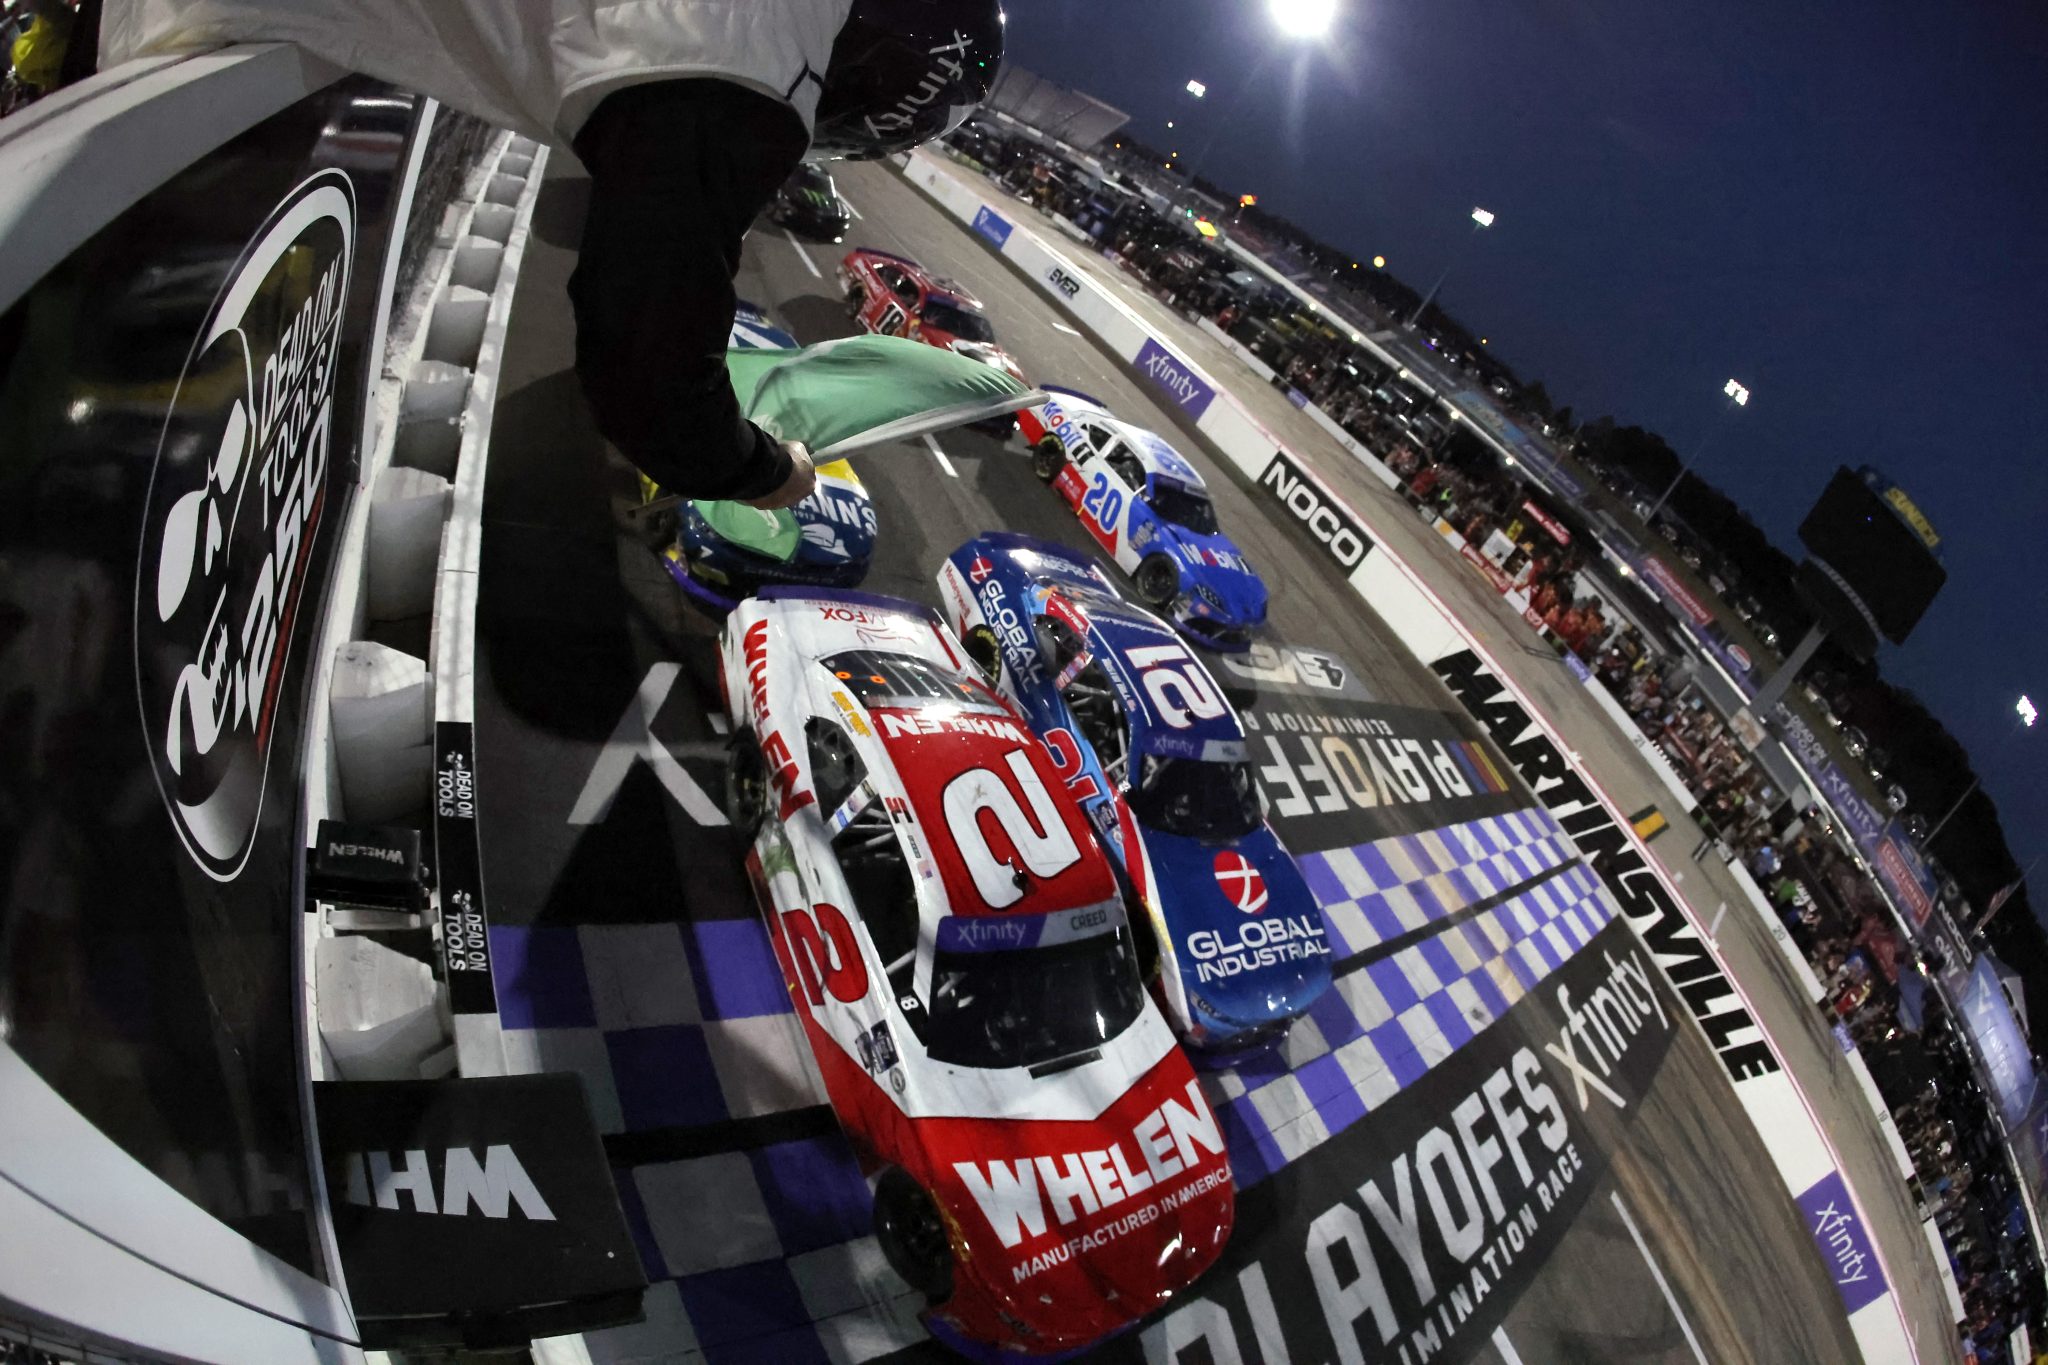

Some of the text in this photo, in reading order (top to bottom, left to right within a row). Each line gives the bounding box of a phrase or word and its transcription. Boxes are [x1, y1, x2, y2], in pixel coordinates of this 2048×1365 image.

[864, 28, 973, 139] xfinity
[259, 250, 343, 450] DEAD ON
[1145, 352, 1199, 405] xfinity
[259, 341, 327, 532] TOOLS
[1043, 400, 1083, 447] Mobil
[1084, 472, 1122, 534] 20
[1268, 460, 1363, 566] NOCO
[241, 395, 331, 735] 250
[985, 579, 1045, 685] GLOBAL
[1125, 645, 1226, 730] 21
[1267, 711, 1394, 736] ELIMINATION
[882, 715, 1029, 745] WHELEN
[1038, 728, 1100, 803] 21
[1154, 736, 1195, 755] xfinity
[438, 770, 455, 818] TOOLS
[456, 770, 474, 819] DEAD ON
[1255, 736, 1473, 818] PLAYOFF
[1824, 770, 1879, 842] xfinity
[1428, 648, 1781, 1083] MARTINSVILLE
[445, 914, 466, 972] TOOLS
[465, 913, 488, 973] DEAD ON
[958, 910, 1107, 948] xfinity CREED
[1187, 915, 1324, 960] GLOBAL
[1196, 939, 1331, 983] INDUSTRIAL
[1936, 902, 1971, 964] NOCO
[1546, 938, 1672, 1111] xfinity
[953, 1078, 1225, 1249] WHELEN
[1012, 1203, 1161, 1284] MANUFACTURED
[1161, 1190, 1181, 1219] IN
[1398, 1147, 1583, 1365] IMINATION RACE
[1816, 1200, 1867, 1285] xfinity
